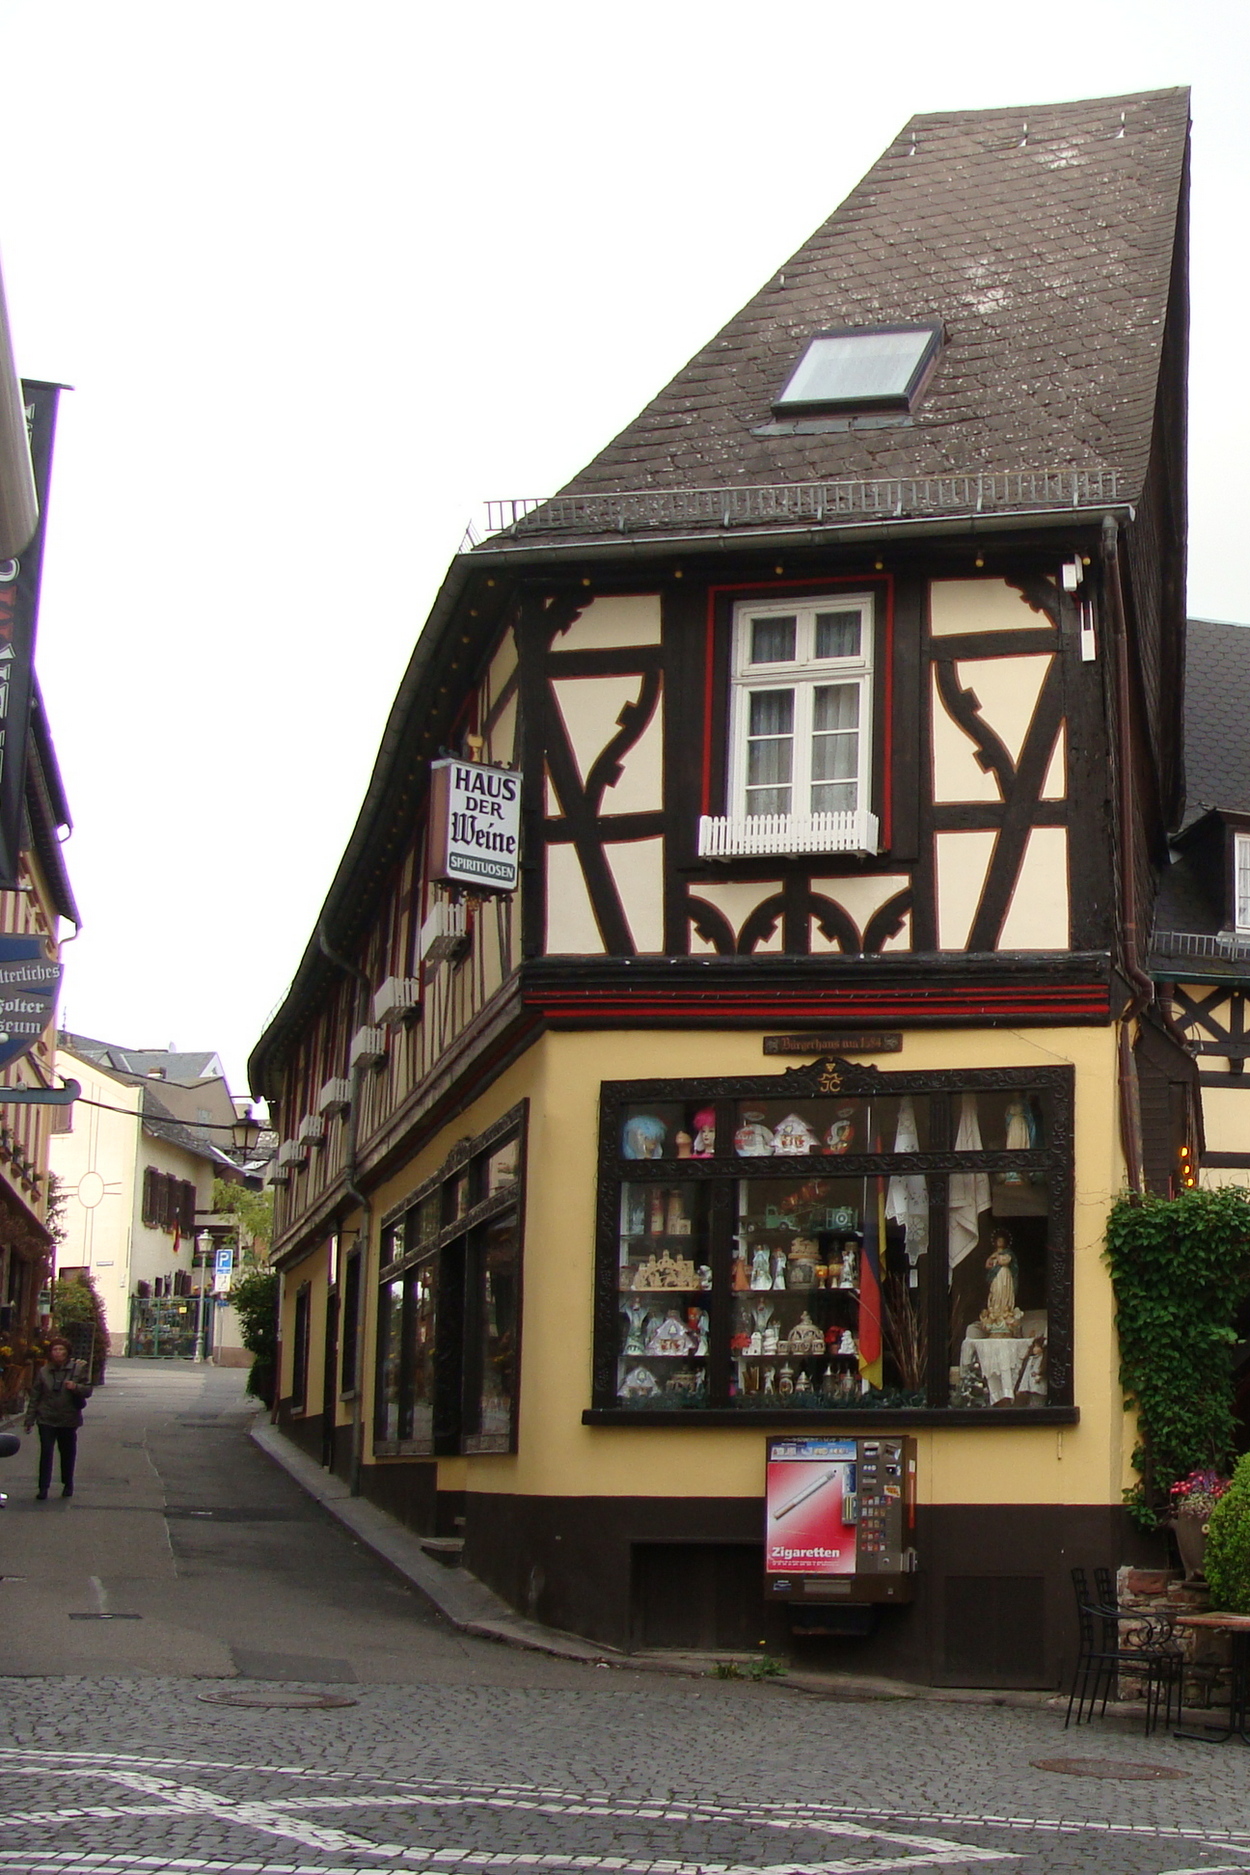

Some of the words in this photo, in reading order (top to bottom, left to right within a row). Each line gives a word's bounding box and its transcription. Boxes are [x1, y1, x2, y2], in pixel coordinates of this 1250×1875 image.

[455, 767, 516, 802] HAUS
[465, 796, 505, 820] DER
[451, 812, 516, 855] Weine
[450, 855, 514, 879] SPIRITUOSEN
[219, 1252, 229, 1267] P
[771, 1546, 840, 1560] Zigaretten
